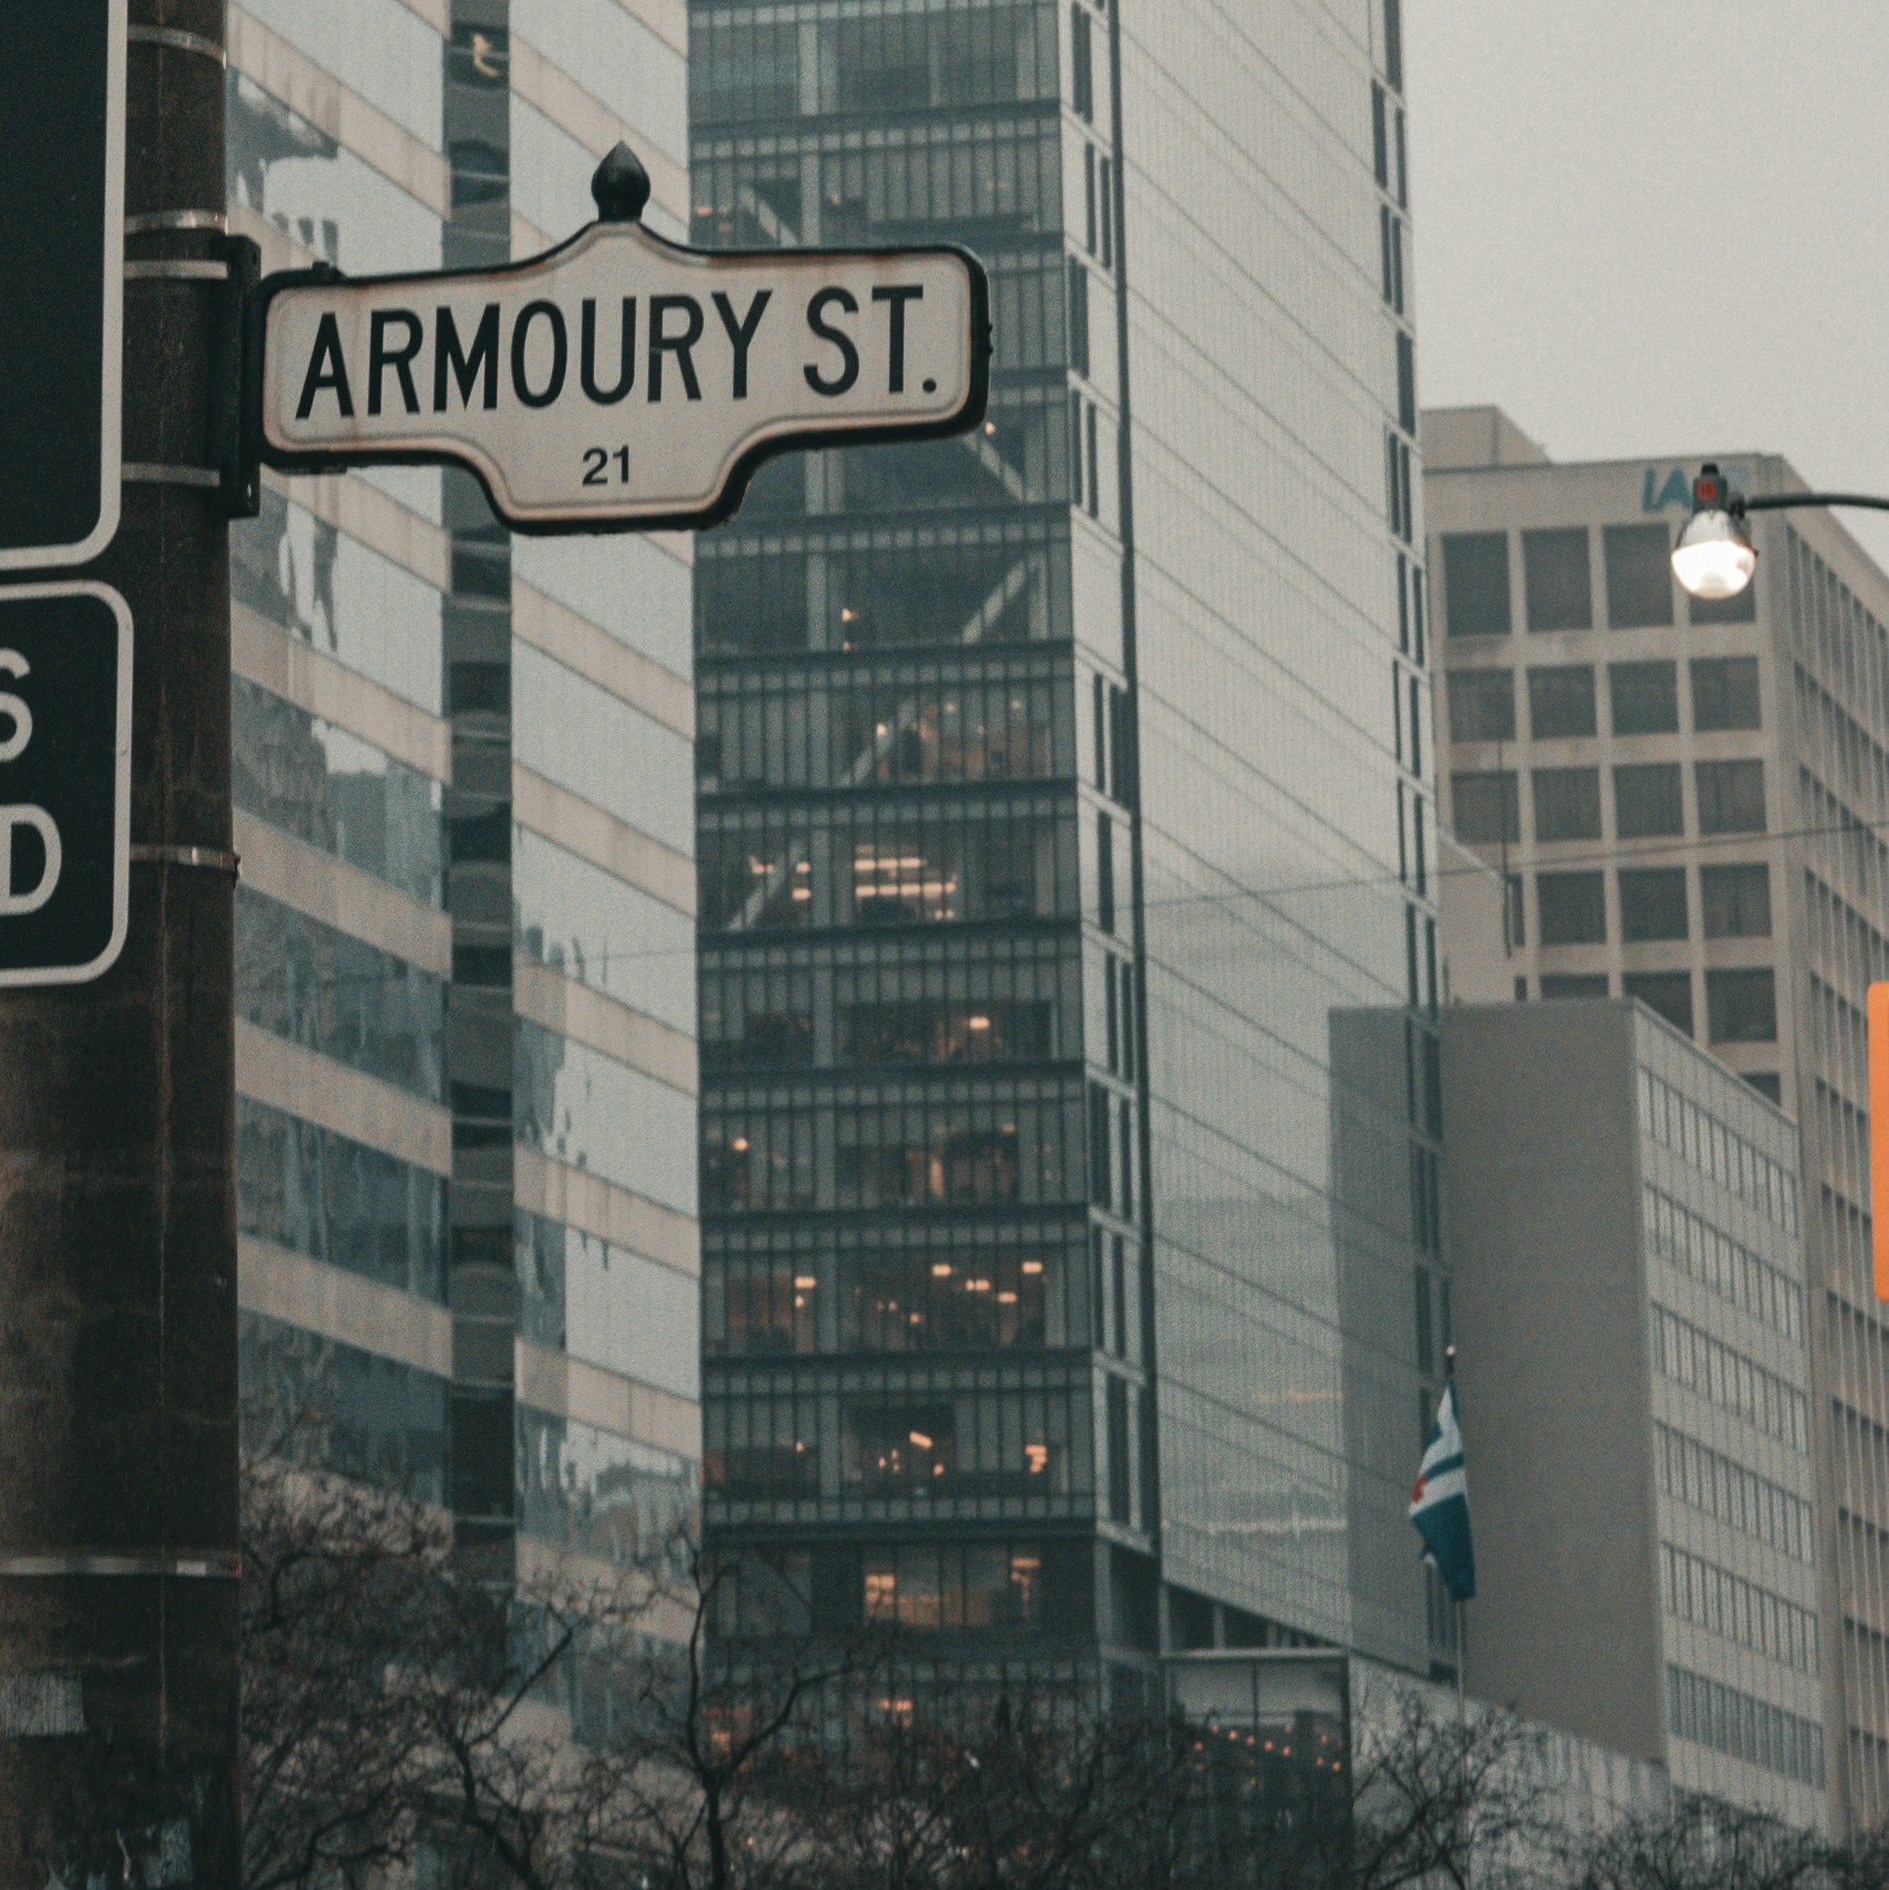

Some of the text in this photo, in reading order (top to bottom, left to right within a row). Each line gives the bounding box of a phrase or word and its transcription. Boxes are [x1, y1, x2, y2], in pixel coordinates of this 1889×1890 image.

[294, 283, 939, 419] ARMOURY ST.
[581, 446, 631, 488] 21
